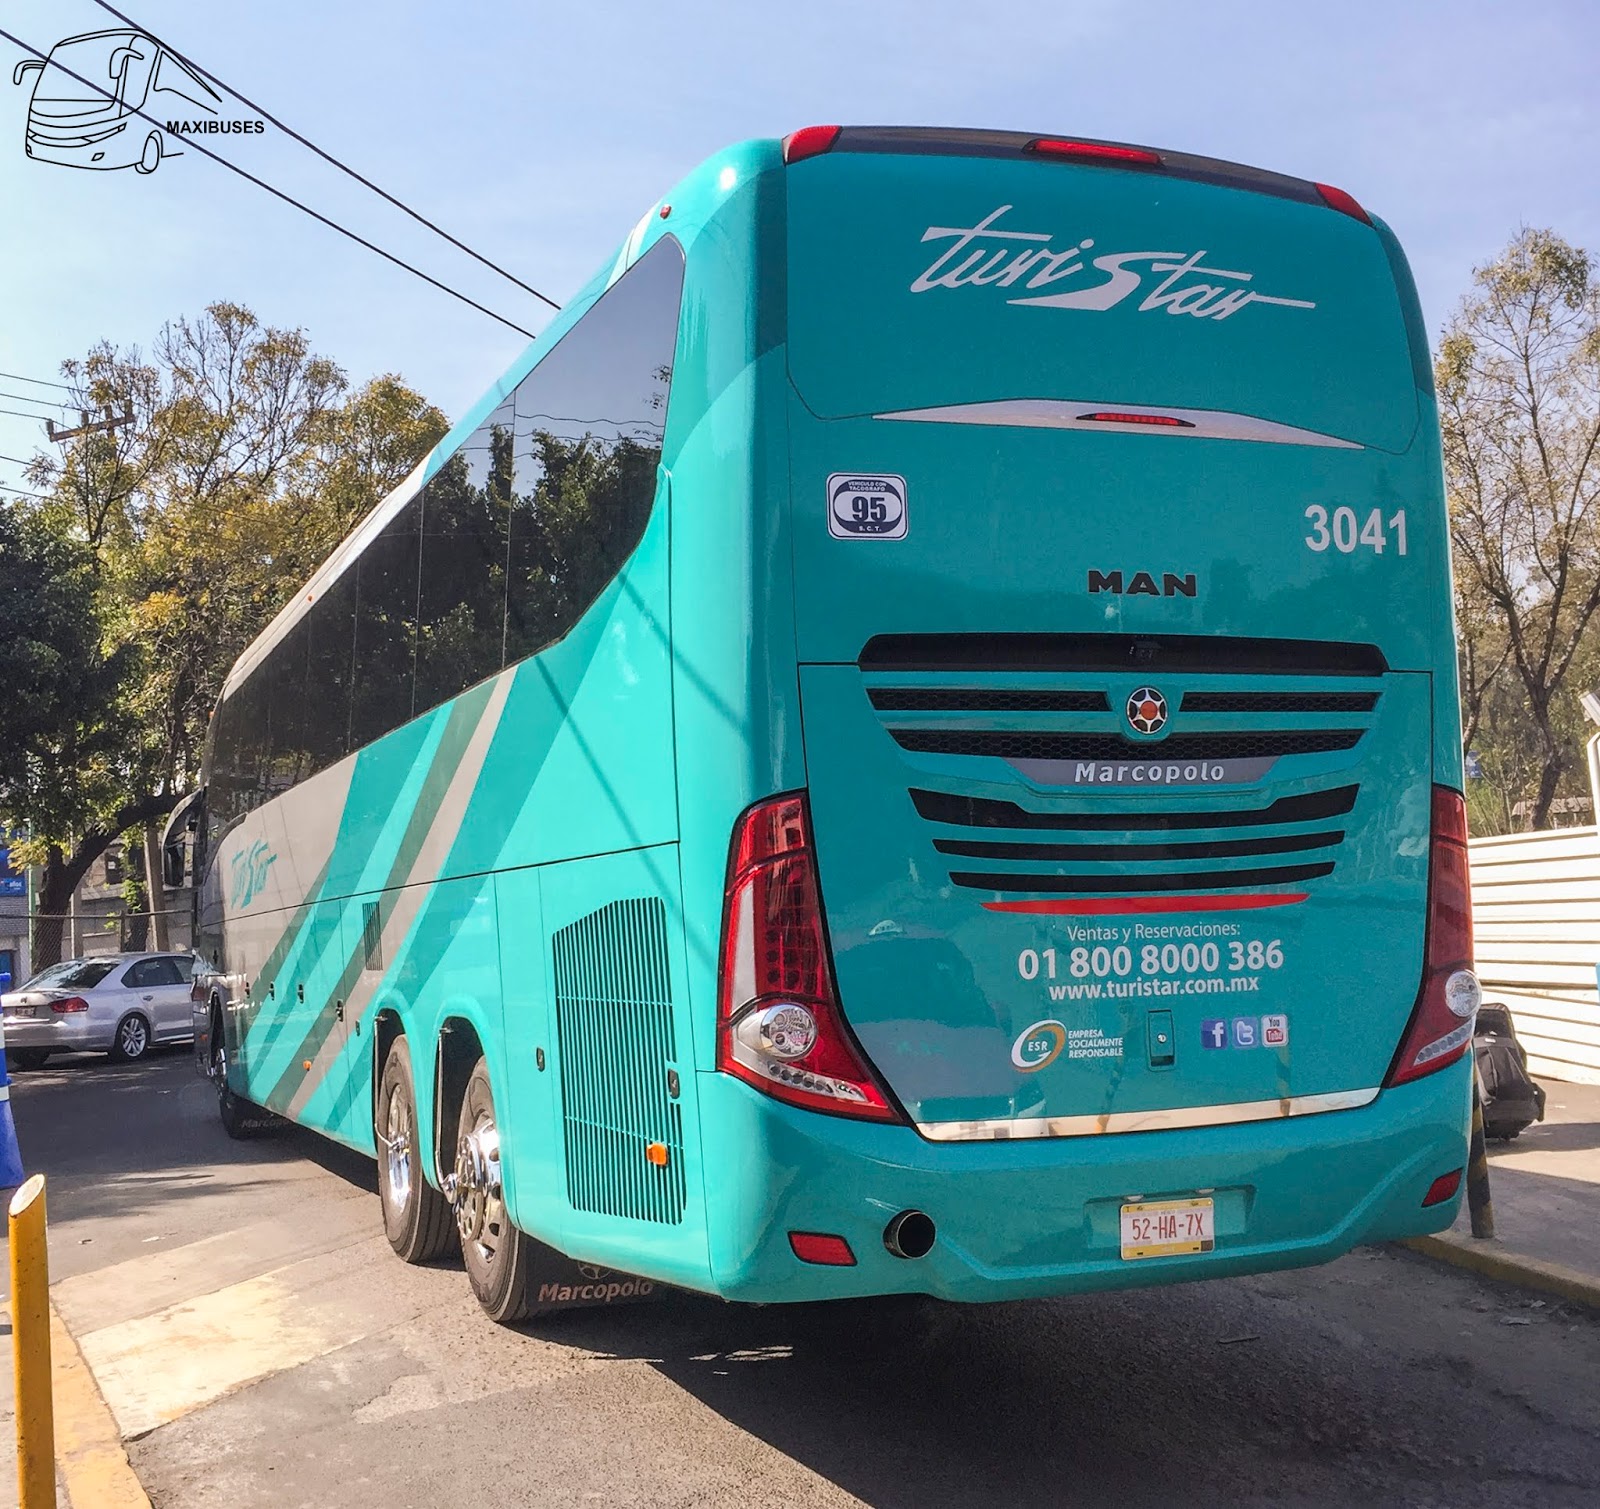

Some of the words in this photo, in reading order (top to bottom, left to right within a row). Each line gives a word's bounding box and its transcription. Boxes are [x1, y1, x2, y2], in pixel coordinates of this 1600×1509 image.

[852, 495, 887, 521] 95
[1304, 504, 1407, 556] 3041
[1088, 569, 1198, 597] MAN
[1074, 761, 1225, 784] Marcopolo
[1067, 925, 1118, 941] Ventas
[1122, 927, 1131, 944] y
[1135, 922, 1241, 939] Reservaciones:
[1018, 948, 1057, 980] 01
[1069, 945, 1132, 978] 800
[1140, 941, 1220, 975] 8000
[1228, 939, 1284, 971] 386
[1048, 975, 1260, 1001] www.turistar.com.mx
[1068, 1029, 1104, 1039] EMPRESA
[1268, 1017, 1280, 1028] You
[1028, 1041, 1048, 1052] ESR
[1068, 1037, 1123, 1049] SOCIALMENTE
[1068, 1047, 1123, 1059] RESPONSABLE
[1132, 1212, 1204, 1241] 52-HA-7X
[538, 1280, 654, 1303] Marcopolo
